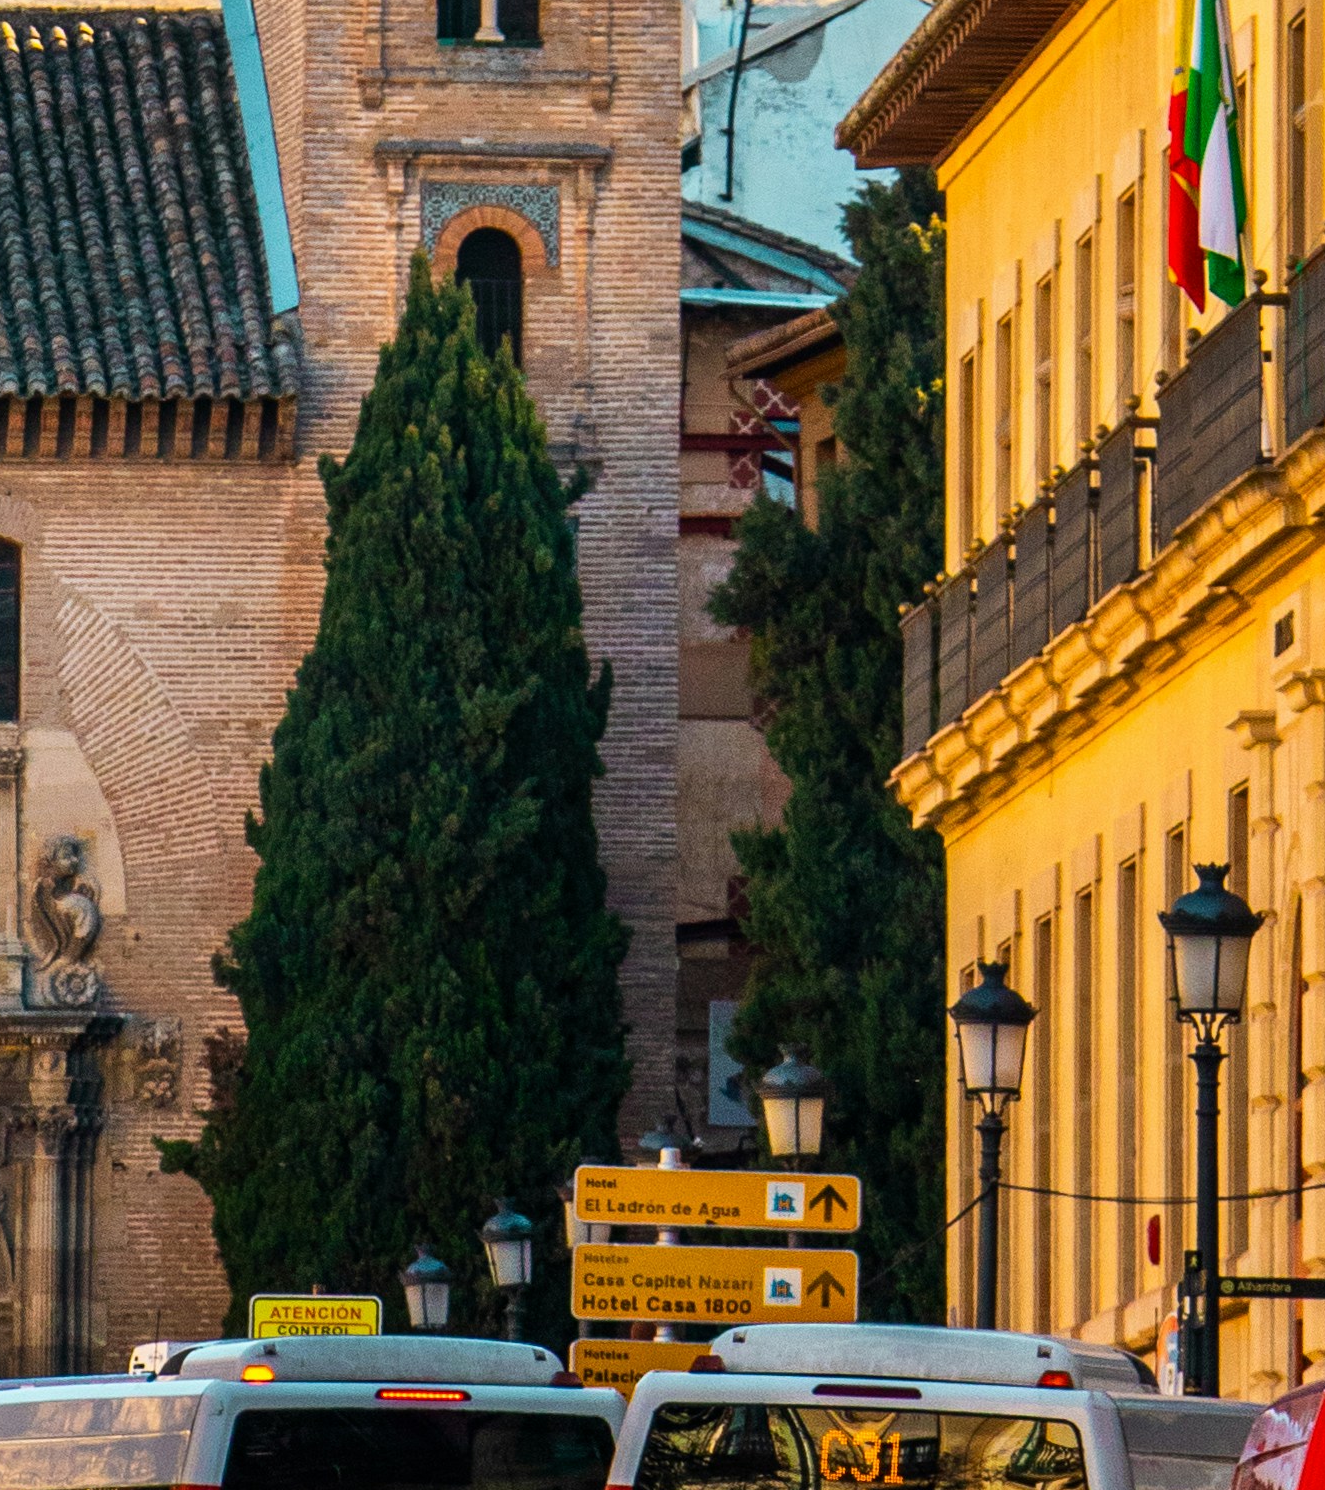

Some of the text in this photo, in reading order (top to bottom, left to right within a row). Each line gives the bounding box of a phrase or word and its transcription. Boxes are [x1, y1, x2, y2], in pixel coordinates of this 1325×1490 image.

[585, 1178, 617, 1189] Hotel
[585, 1199, 601, 1212] El
[671, 1199, 692, 1216] de
[698, 1202, 741, 1218] Agua
[583, 1252, 629, 1264] Hoteles
[583, 1273, 625, 1287] Casa
[632, 1273, 692, 1291] Capitel
[1237, 1281, 1293, 1294] Alhambra
[581, 1294, 752, 1315] Hotel Casa 1800
[269, 1304, 362, 1320] ATENCIÓN
[277, 1325, 350, 1335] CONTROL
[583, 1350, 629, 1361] Hoteles
